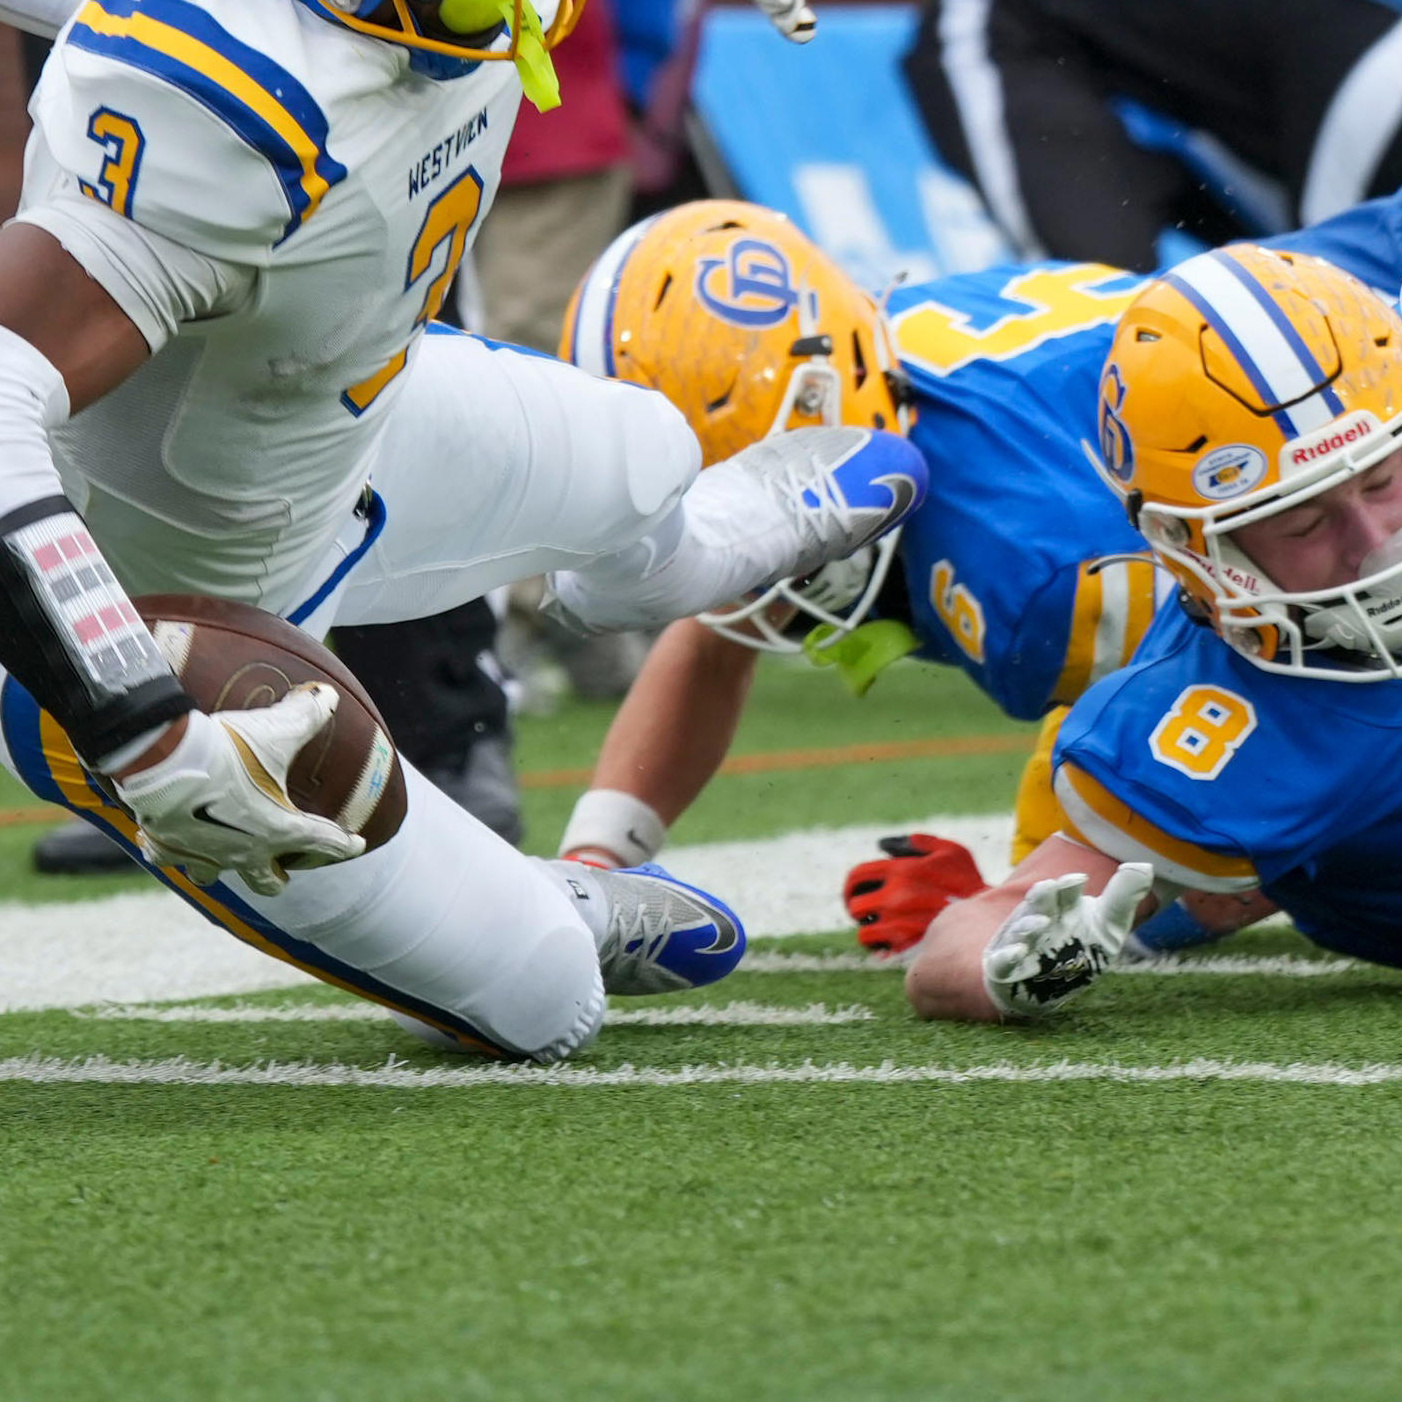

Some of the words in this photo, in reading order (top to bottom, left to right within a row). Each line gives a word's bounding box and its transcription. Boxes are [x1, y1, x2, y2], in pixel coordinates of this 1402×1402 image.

[77, 104, 146, 221] 3
[409, 107, 489, 200] WESTVIEW
[1292, 419, 1372, 467] Riddell
[1149, 684, 1258, 781] 8
